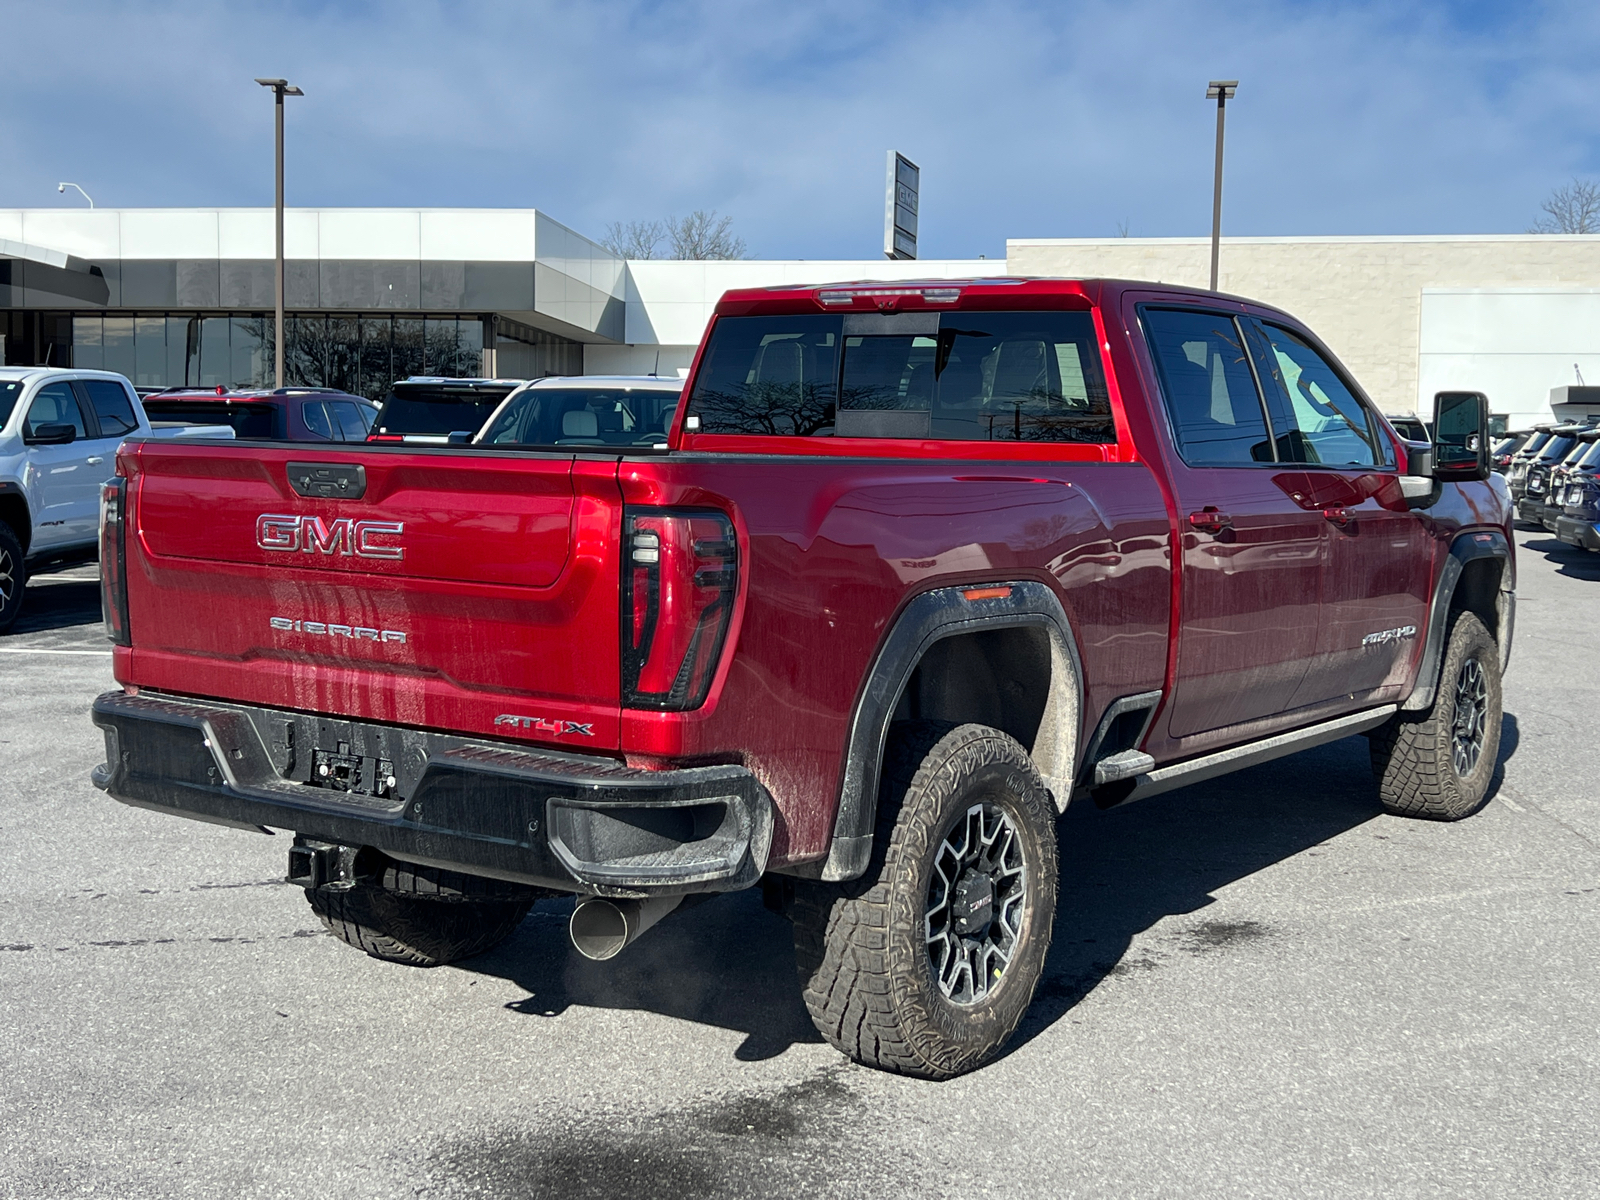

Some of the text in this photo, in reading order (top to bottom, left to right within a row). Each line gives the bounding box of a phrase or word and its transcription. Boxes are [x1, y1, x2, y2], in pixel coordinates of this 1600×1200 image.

[256, 514, 405, 560] GMC
[270, 616, 406, 644] SIERRA
[1397, 625, 1416, 637] HD
[494, 713, 595, 736] AT4X
